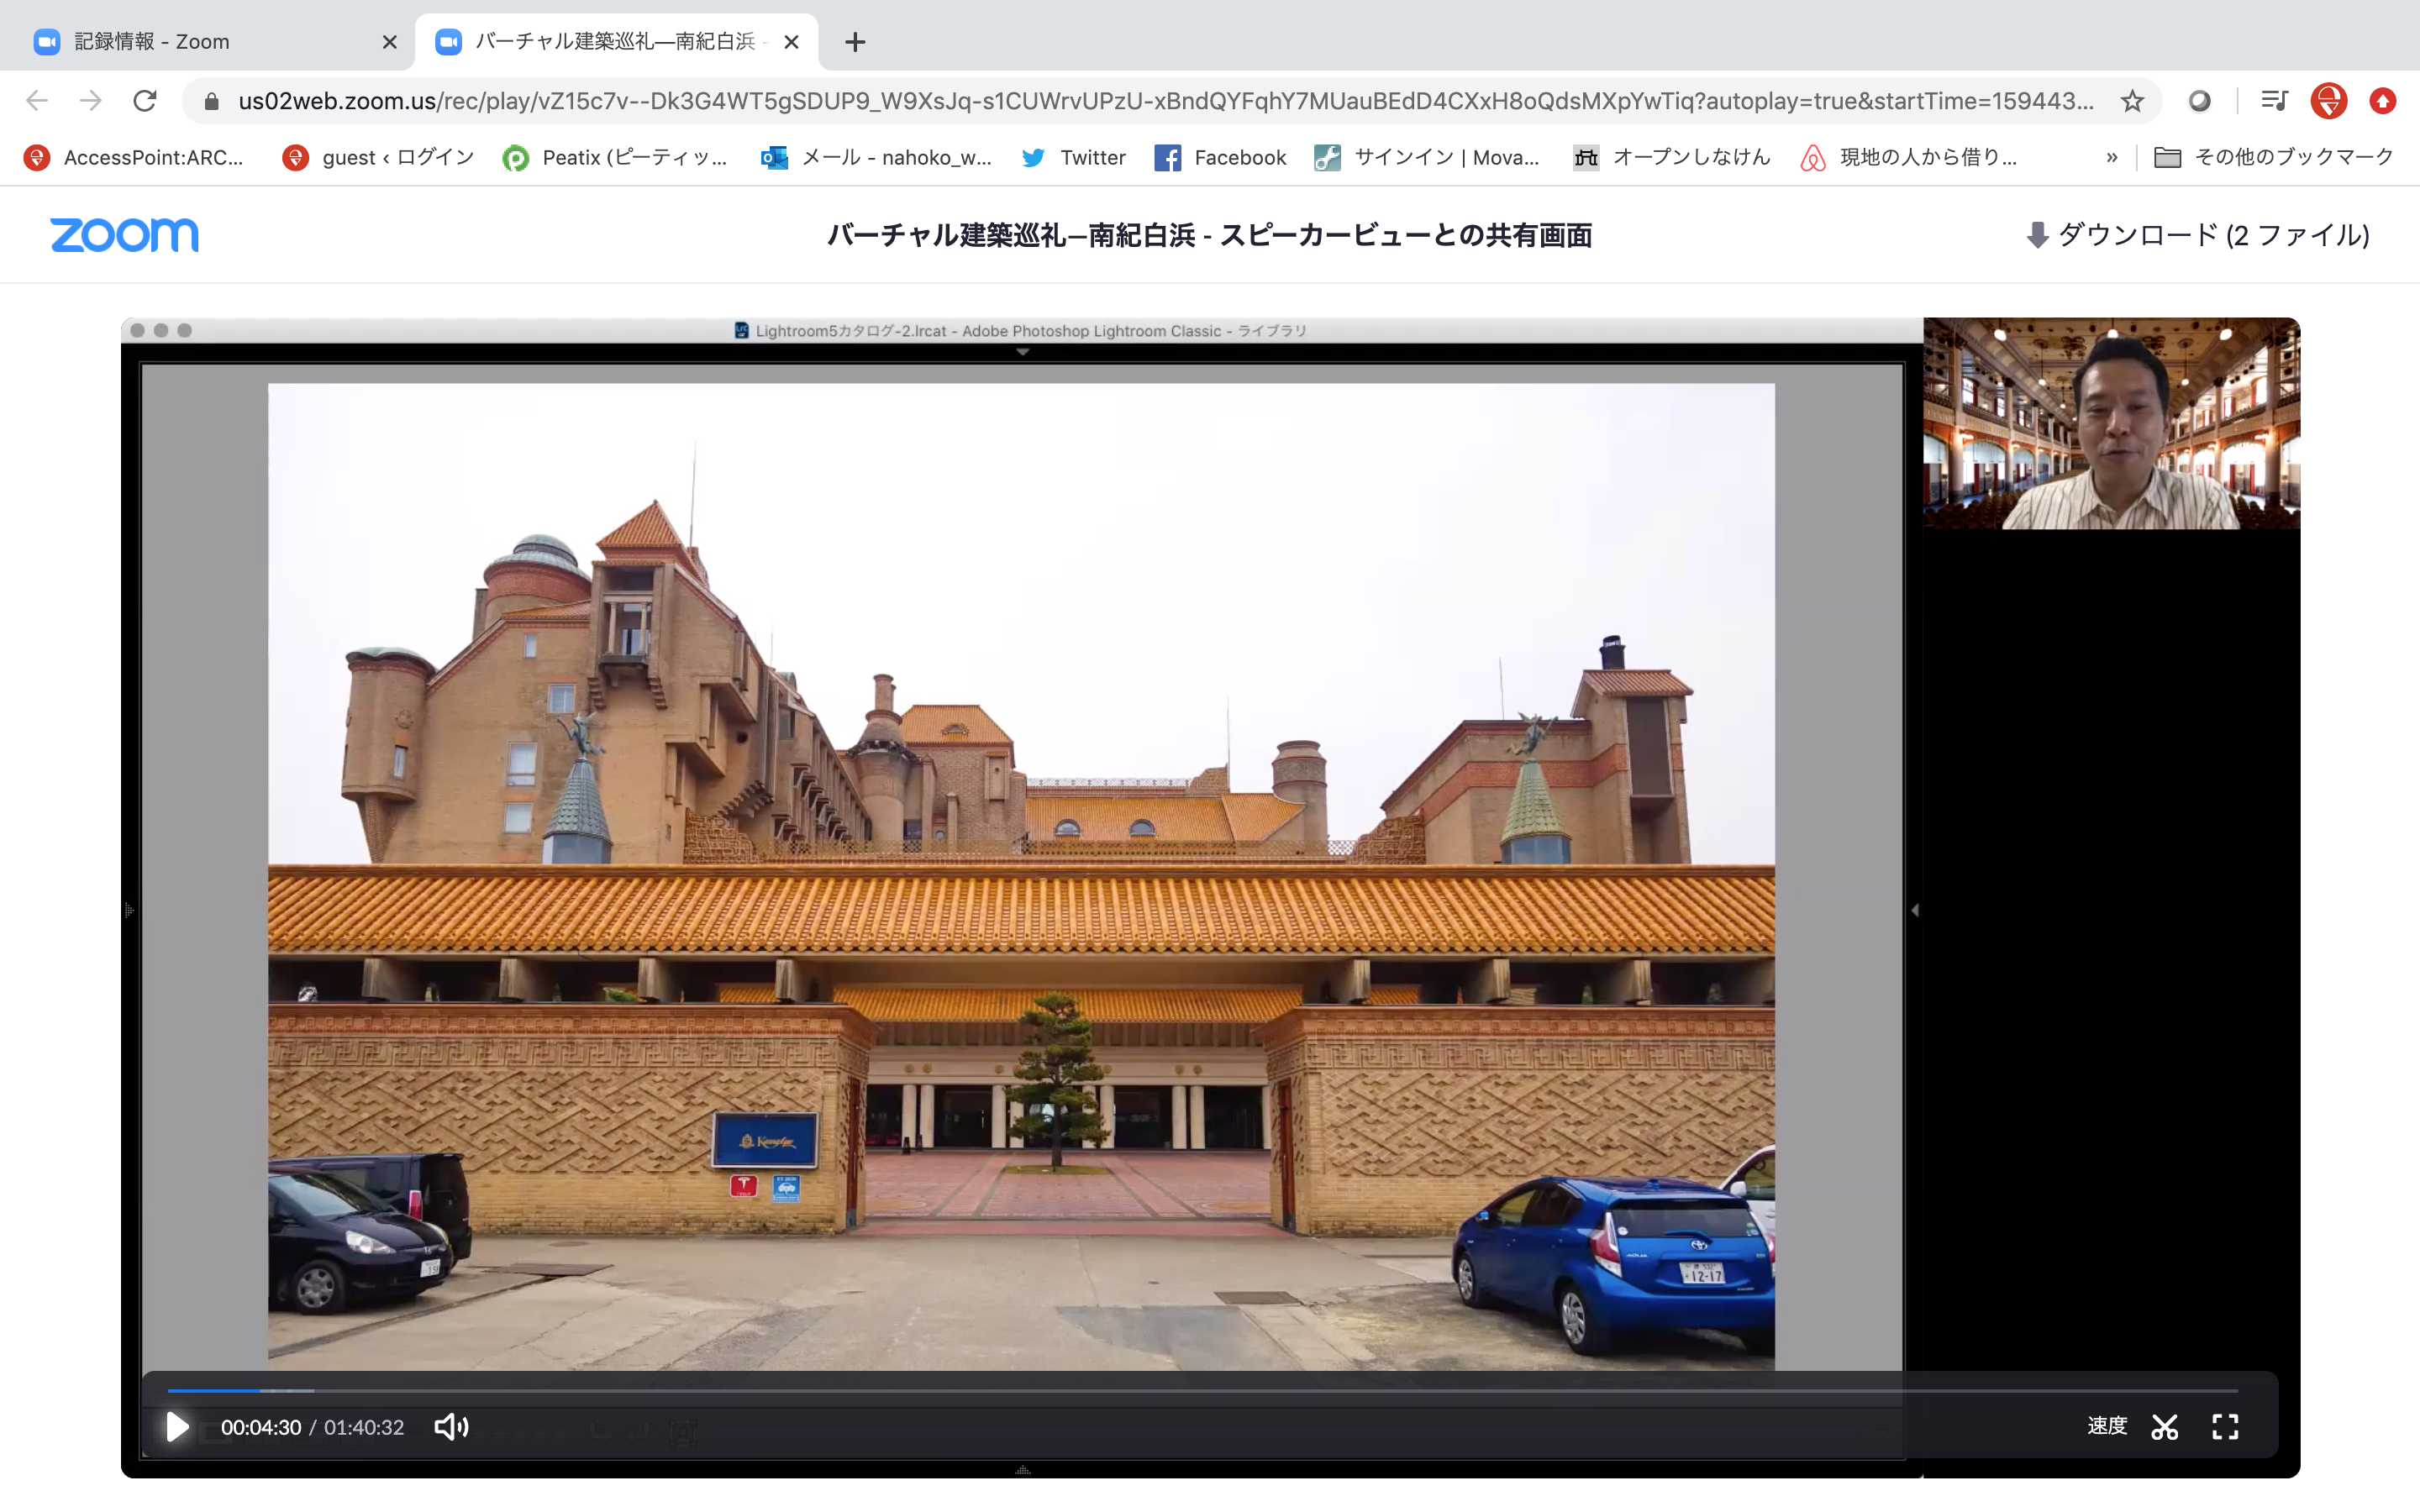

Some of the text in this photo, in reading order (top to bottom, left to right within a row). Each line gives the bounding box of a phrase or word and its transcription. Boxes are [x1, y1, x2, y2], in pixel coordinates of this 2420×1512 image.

[75, 31, 155, 51] 記録情報
[176, 34, 229, 50] Zoom
[64, 149, 243, 166] AccessPoint:ARC...
[323, 150, 376, 170] guest
[398, 147, 474, 166] ログイン
[544, 149, 601, 166] Peatix
[802, 148, 861, 166] メール
[883, 149, 992, 168] nahoko_w...
[1060, 149, 1127, 165] Twitter
[1196, 149, 1287, 165] Facebook
[1355, 148, 1454, 166] サインイン
[1474, 150, 1539, 165] Mova...
[1614, 147, 1771, 166] オープンしなけん
[1840, 147, 2017, 167] 現地の人から借り...
[2196, 147, 2392, 167] その他のブックマーク
[50, 218, 199, 253] zoom
[1220, 221, 1593, 249] スピーカービューとの共有画面
[2060, 221, 2370, 250] ダウンロード (2 ファイル)
[755, 324, 947, 340] Lightroom5カタログ-2.lrcat
[962, 324, 1008, 338] Adobe
[1013, 324, 1090, 339] Photoshop
[1094, 324, 1166, 340] Lightroom
[1171, 324, 1222, 338] Classic
[1239, 324, 1307, 338] ライブラリ
[1691, 1270, 1723, 1283] 12-17
[221, 1419, 404, 1437] 00:04:30 / 01:40:32
[2087, 1415, 2128, 1436] 速度
